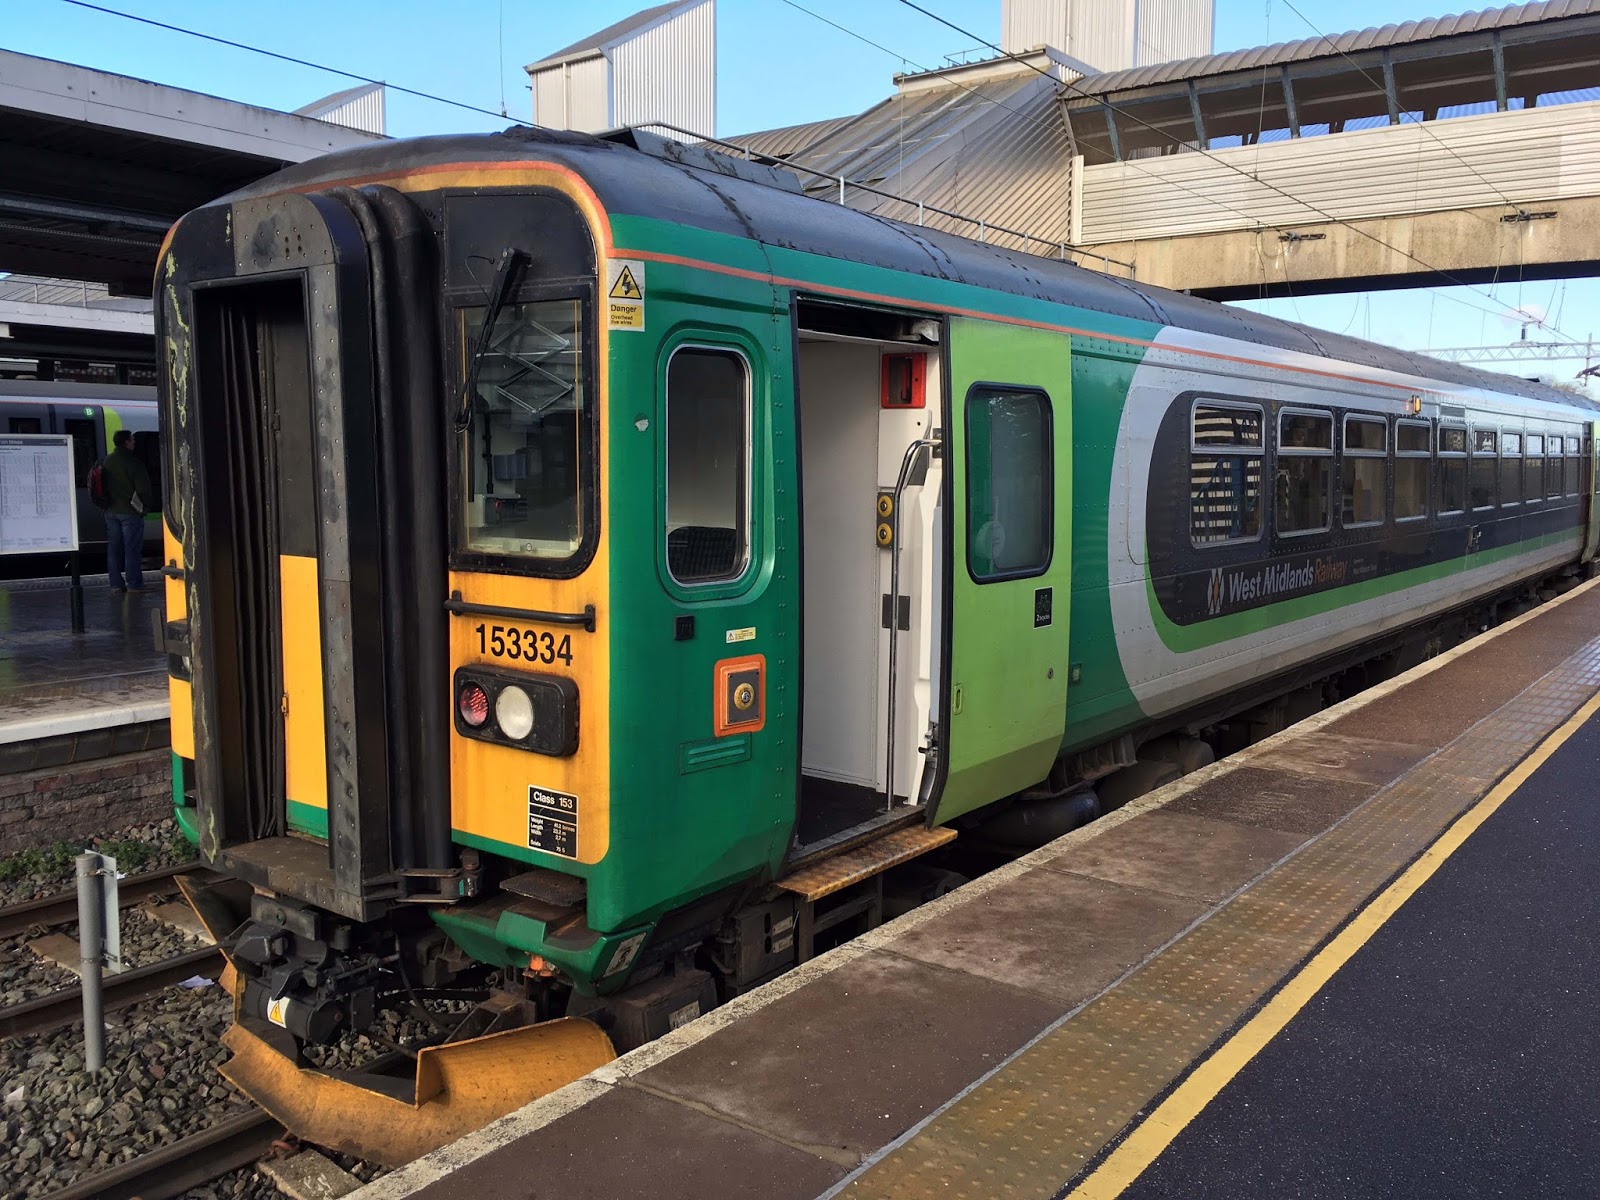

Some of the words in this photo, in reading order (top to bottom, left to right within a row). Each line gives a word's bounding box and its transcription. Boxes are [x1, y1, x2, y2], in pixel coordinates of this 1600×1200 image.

[610, 304, 637, 315] Danger
[86, 408, 93, 416] B
[1229, 571, 1261, 603] West
[1262, 559, 1314, 596] Midlands
[1314, 557, 1348, 584] Railway
[475, 623, 573, 667] 153334
[533, 791, 555, 805] Class
[559, 797, 573, 809] 153
